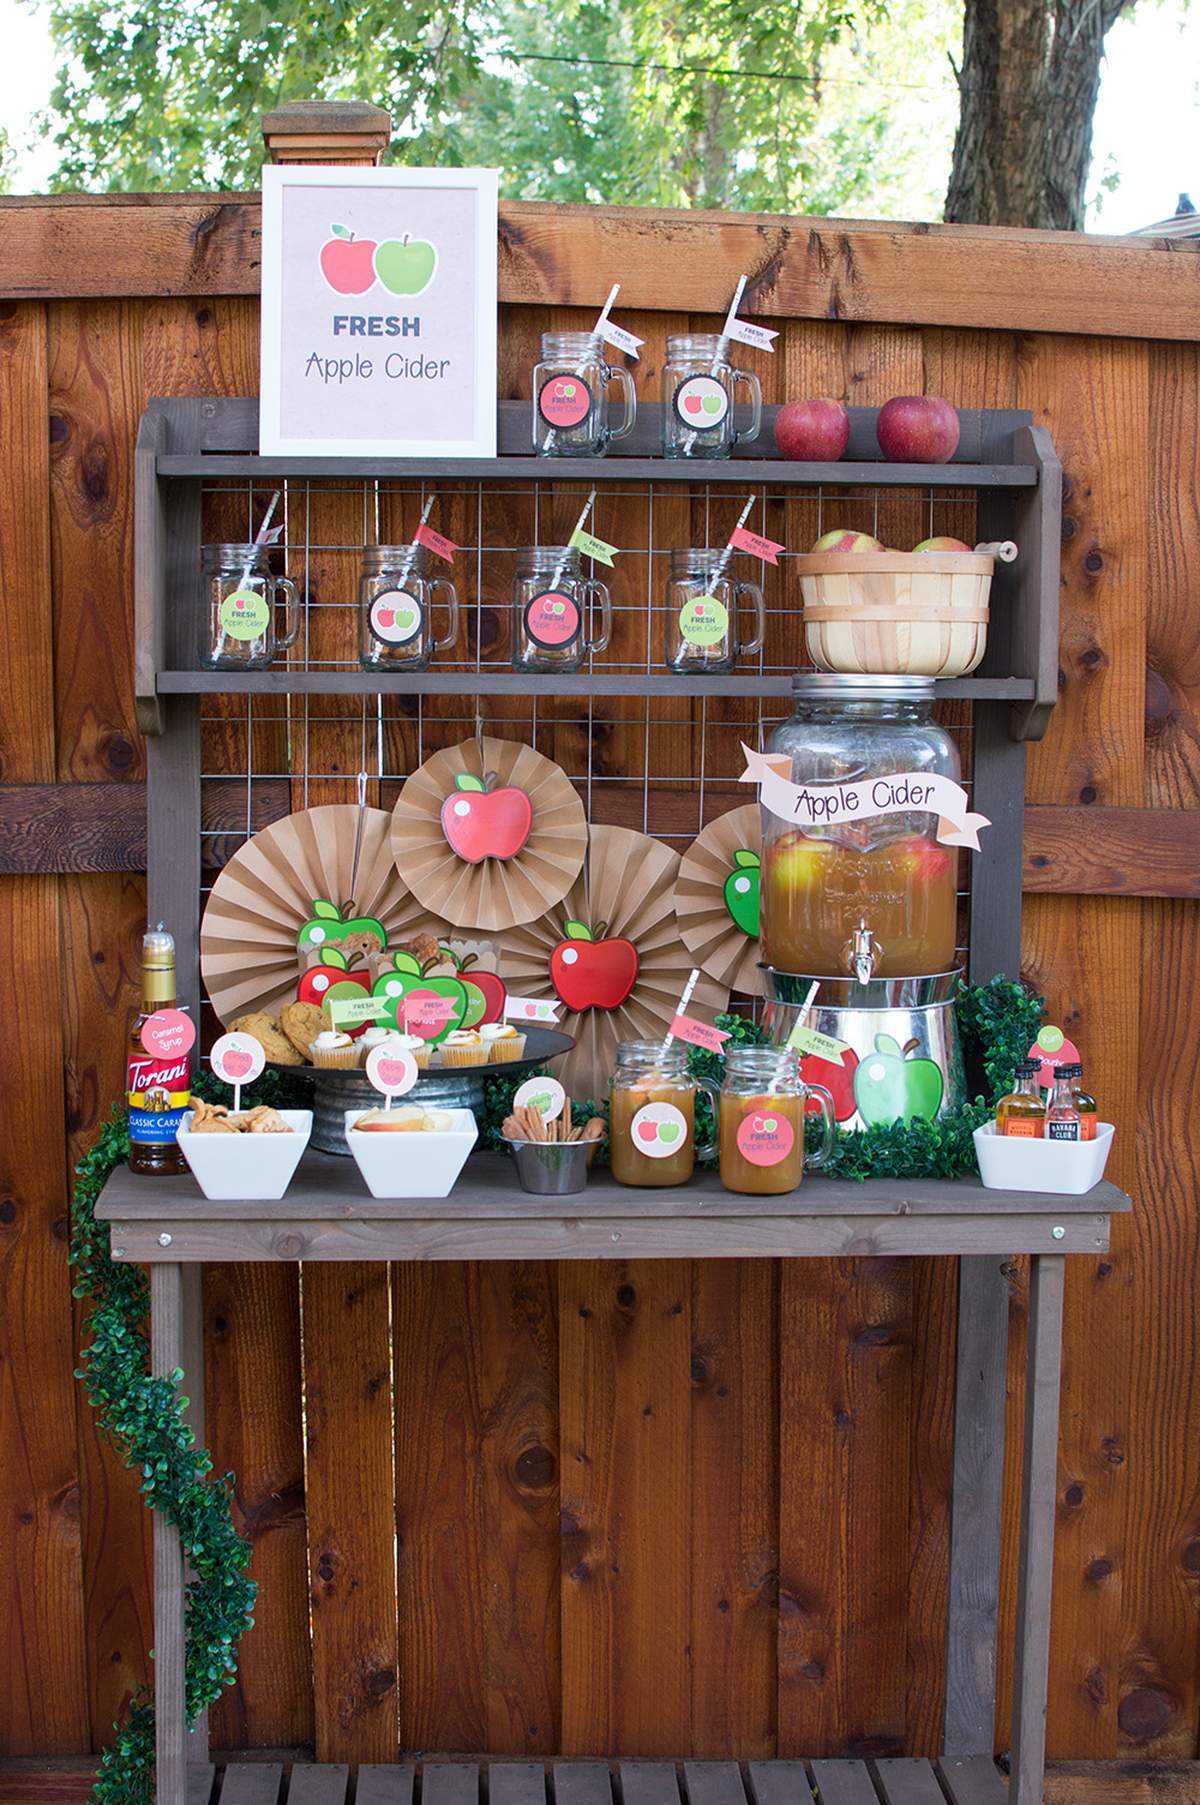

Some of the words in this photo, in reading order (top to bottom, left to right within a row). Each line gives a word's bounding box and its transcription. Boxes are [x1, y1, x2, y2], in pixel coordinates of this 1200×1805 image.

[333, 315, 421, 337] FRESH
[744, 327, 765, 338] FRESH
[304, 351, 374, 384] Apple
[384, 352, 451, 380] Cider
[551, 396, 577, 404] FRESH
[751, 537, 770, 549] FRESH
[539, 612, 565, 621] FRESH
[224, 619, 244, 628] Apple
[245, 619, 265, 628] Cider
[683, 624, 703, 633] Apple
[704, 624, 724, 633] Cider
[793, 787, 860, 823] Apple
[871, 778, 936, 809] Cider
[353, 1002, 375, 1010] FRESH
[151, 1023, 185, 1040] Caramel
[692, 1025, 715, 1038] FRESH
[158, 1037, 184, 1052] Syrup
[813, 1036, 835, 1049] FRESH
[129, 1056, 188, 1097] Torani
[129, 1115, 155, 1128] CLASSIC
[156, 1117, 184, 1128] CARA
[750, 1132, 778, 1140] FRESH
[1055, 1131, 1073, 1139] CLUB
[741, 1142, 765, 1152] Apple
[765, 1141, 787, 1151] Cider
